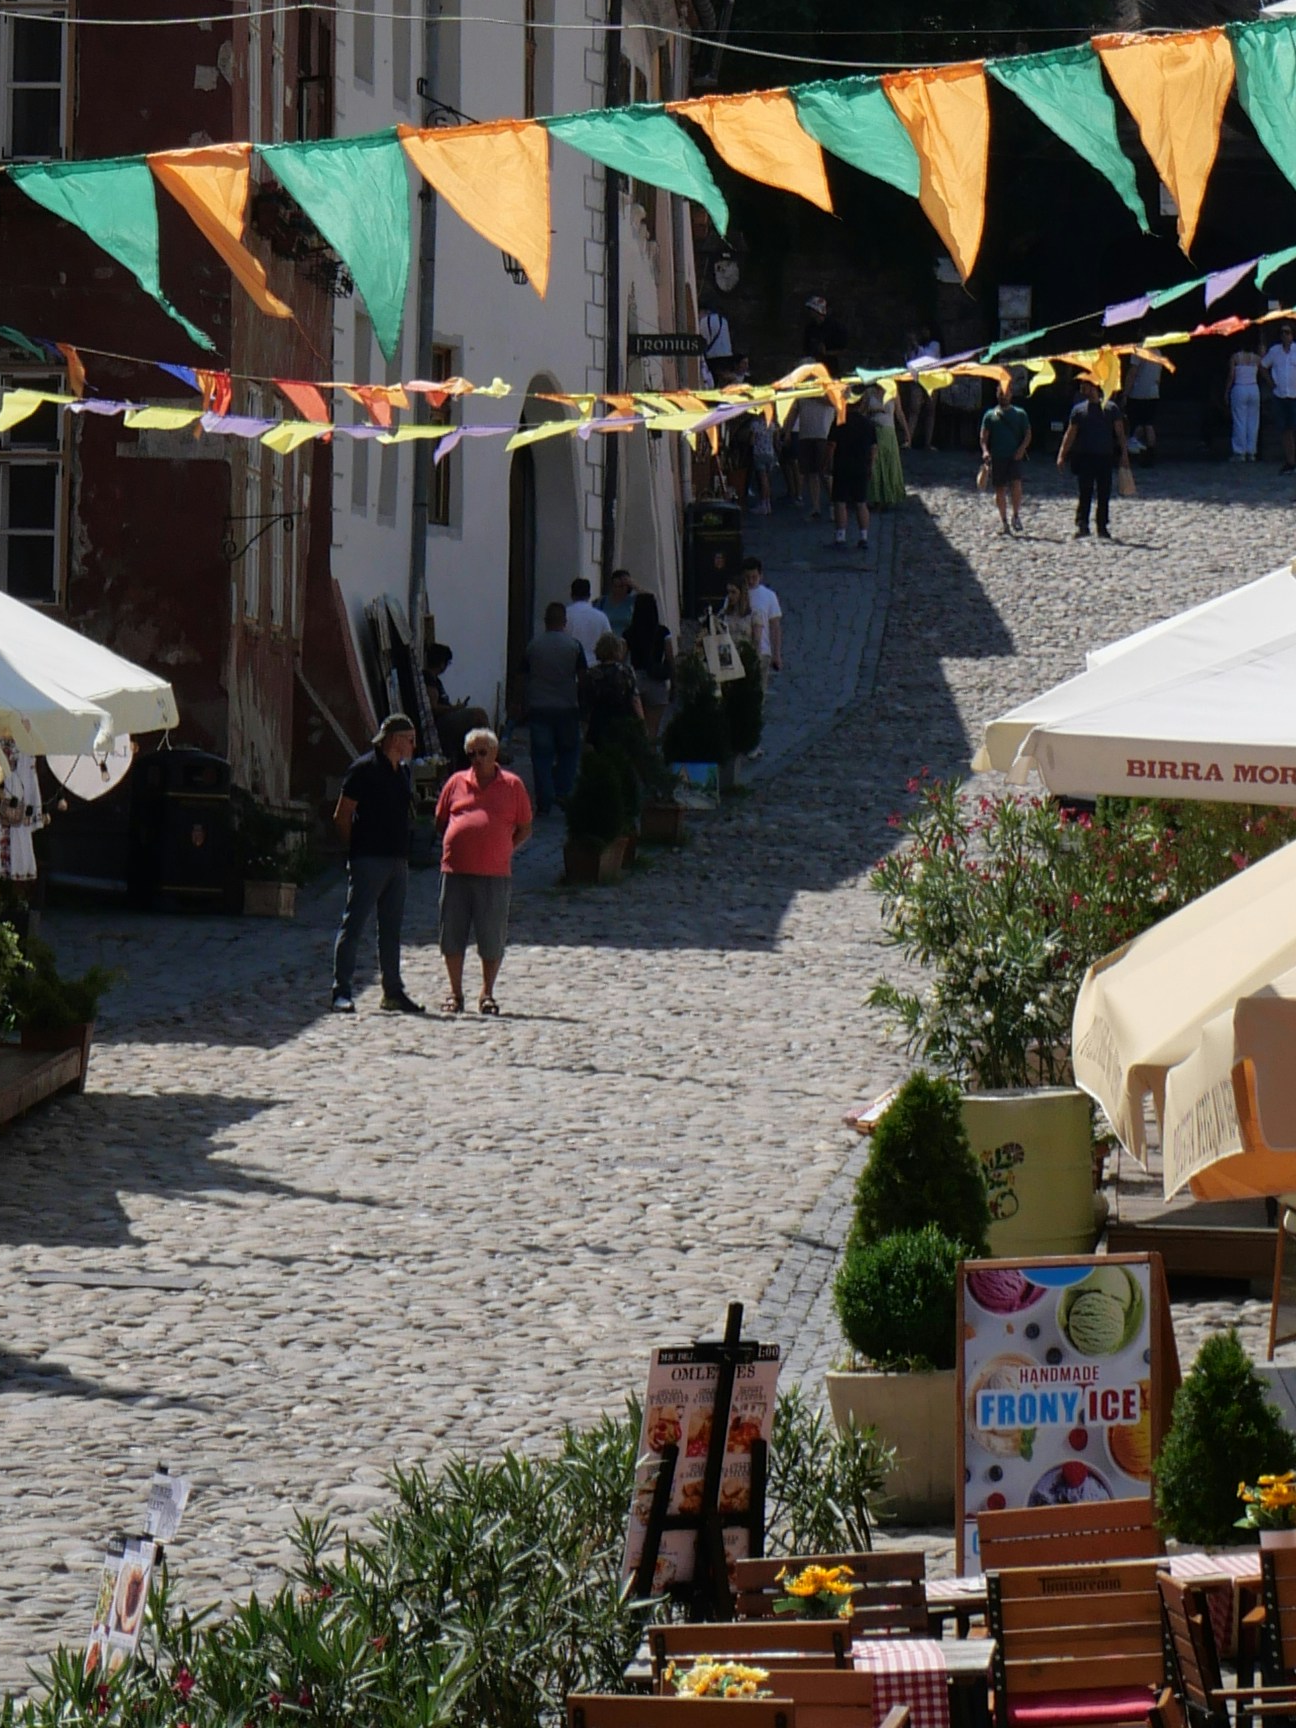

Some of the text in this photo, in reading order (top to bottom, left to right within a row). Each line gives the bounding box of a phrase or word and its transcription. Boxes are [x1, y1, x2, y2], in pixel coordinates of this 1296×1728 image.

[1126, 759, 1224, 782] BIRRA
[671, 1365, 756, 1381] OMLEES
[1019, 1365, 1100, 1384] HANDMADE
[981, 1389, 1138, 1426] FRONY ICE
